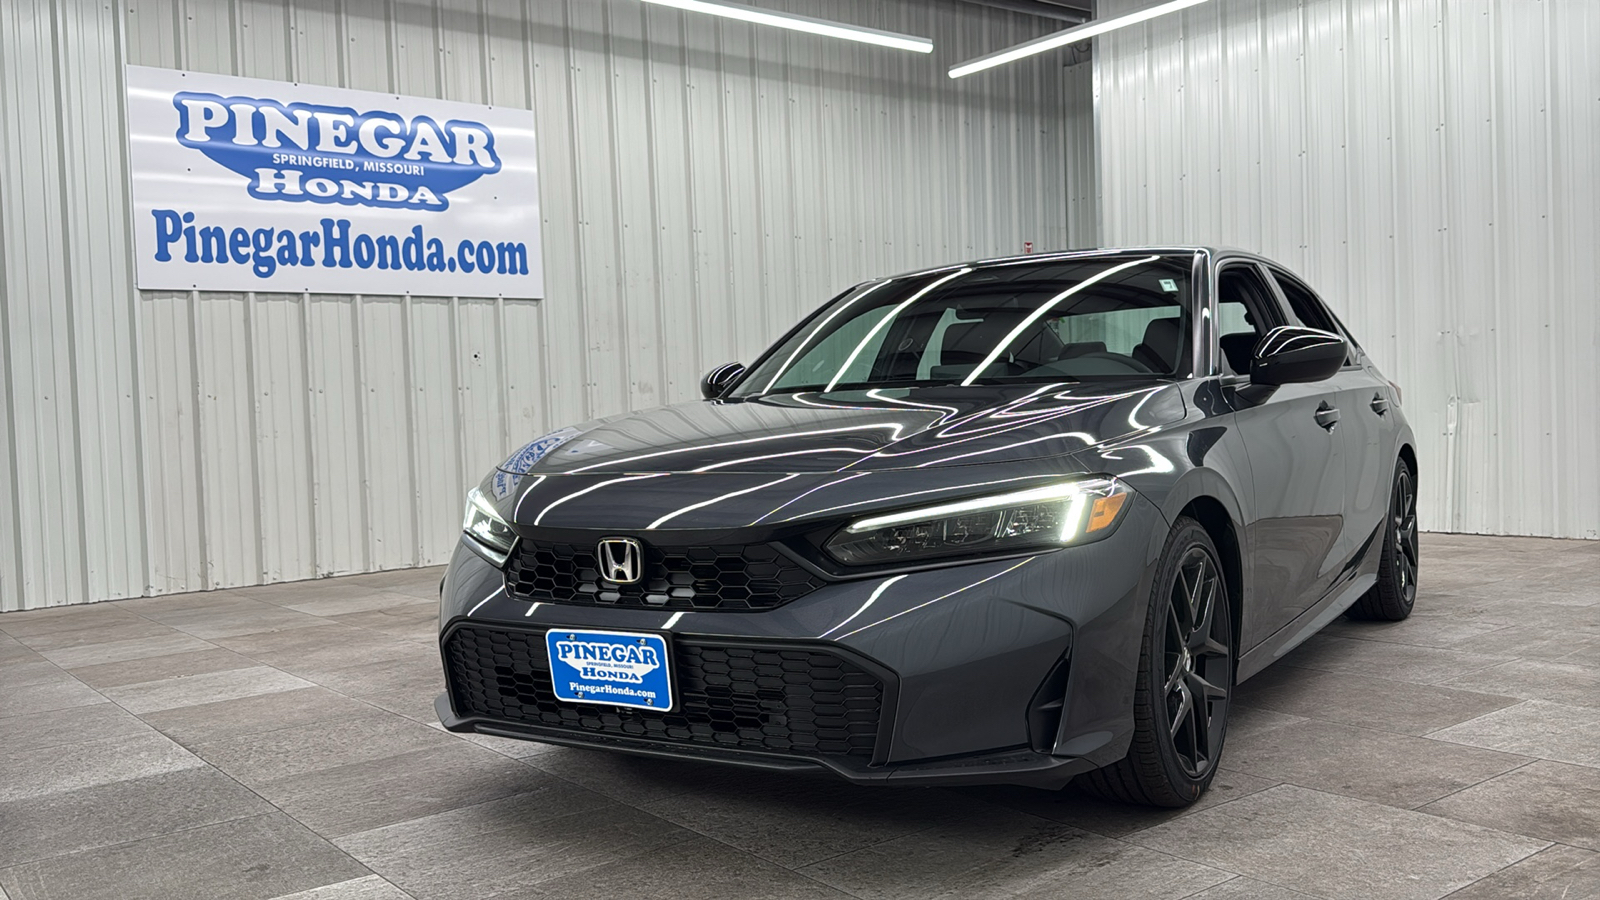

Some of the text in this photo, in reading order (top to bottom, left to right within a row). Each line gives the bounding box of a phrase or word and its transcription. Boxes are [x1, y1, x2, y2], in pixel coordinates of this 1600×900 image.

[181, 98, 497, 168] PINEGAR
[272, 152, 425, 176] SPRINGFIELD, MISSOURI
[254, 168, 443, 205] HONDA
[152, 209, 529, 279] PinegarHonda.com
[558, 643, 657, 666] PINEGAR
[581, 667, 640, 681] HONDA
[569, 682, 656, 698] PinegarHonda.com
